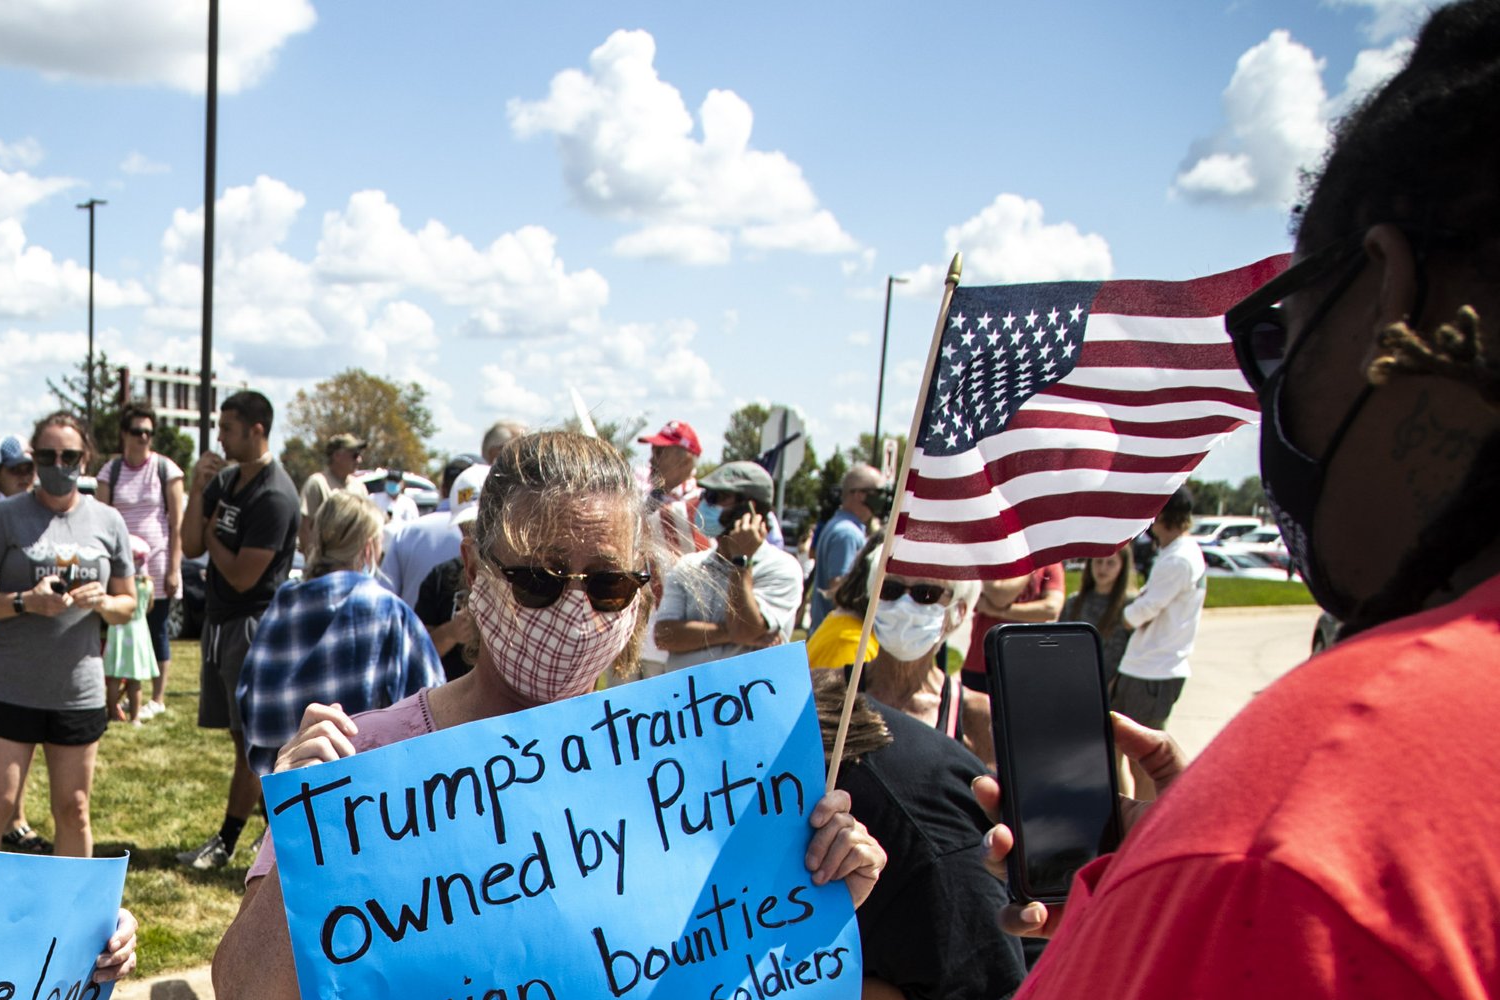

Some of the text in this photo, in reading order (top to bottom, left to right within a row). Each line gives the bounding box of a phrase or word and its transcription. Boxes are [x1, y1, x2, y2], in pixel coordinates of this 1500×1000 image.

[561, 733, 592, 773] a
[591, 675, 777, 767] traitor
[320, 757, 805, 965] owned by Putin
[591, 884, 815, 998] bounties
